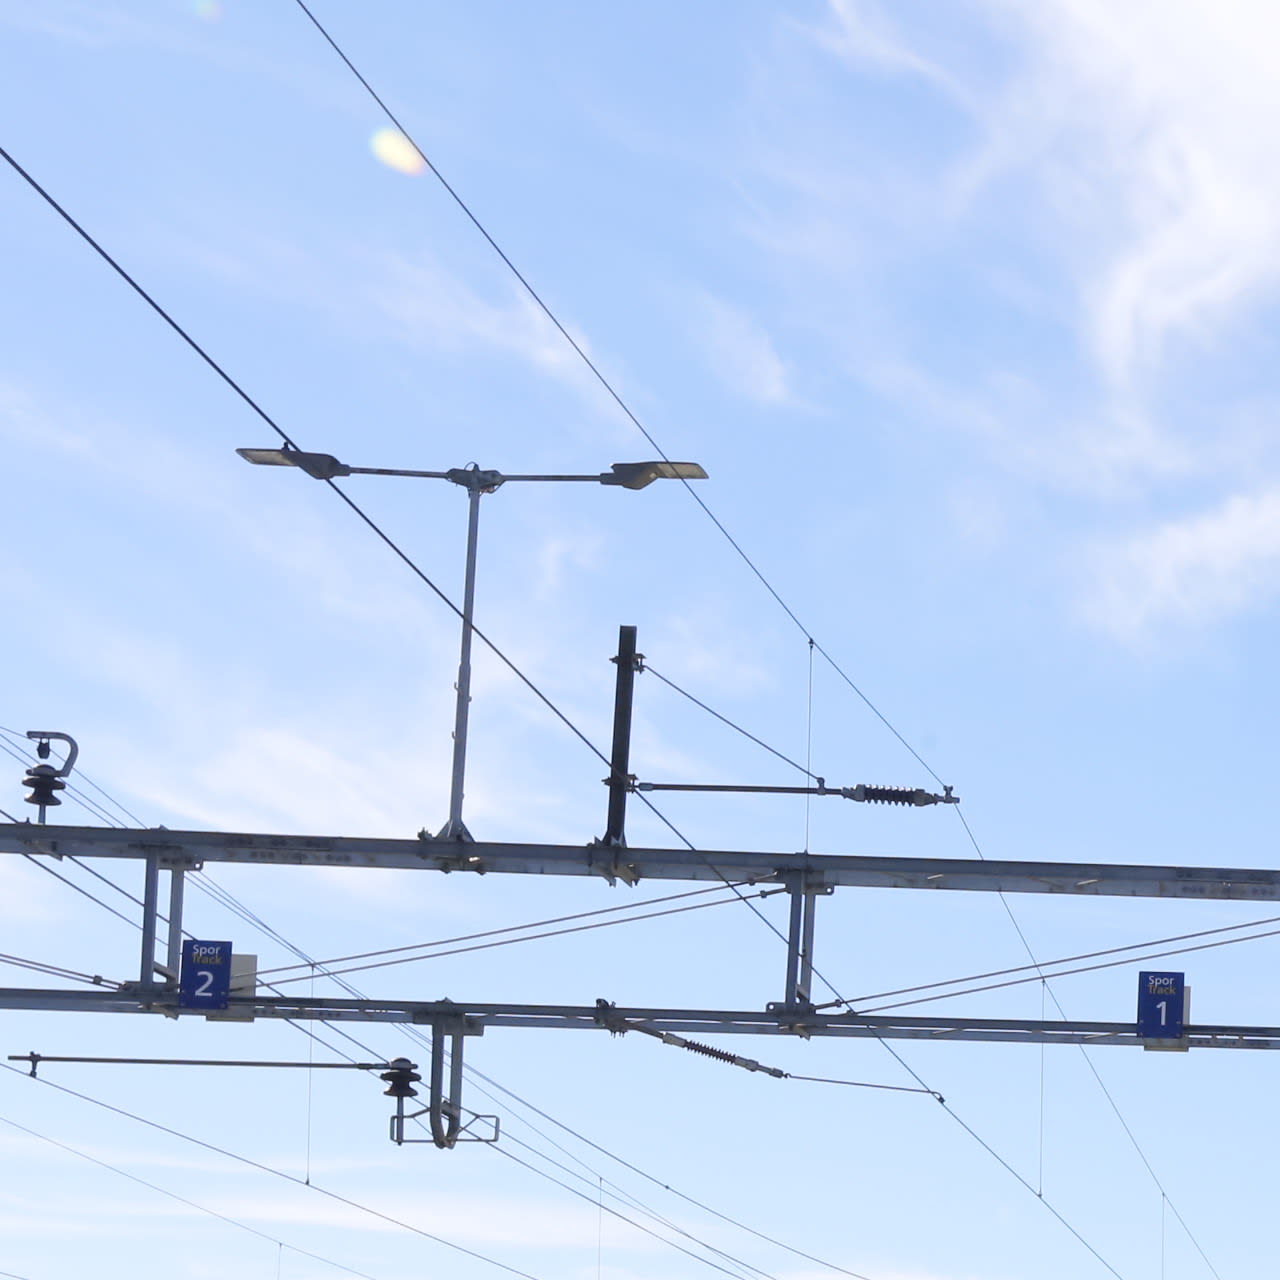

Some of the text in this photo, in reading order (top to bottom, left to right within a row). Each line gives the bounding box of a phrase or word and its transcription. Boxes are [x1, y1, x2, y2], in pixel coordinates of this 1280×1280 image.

[193, 944, 221, 957] Spor
[192, 953, 222, 965] Track
[195, 971, 213, 997] 2
[1148, 975, 1175, 987] Spor
[1148, 984, 1176, 995] Track
[1156, 1001, 1167, 1026] 1
